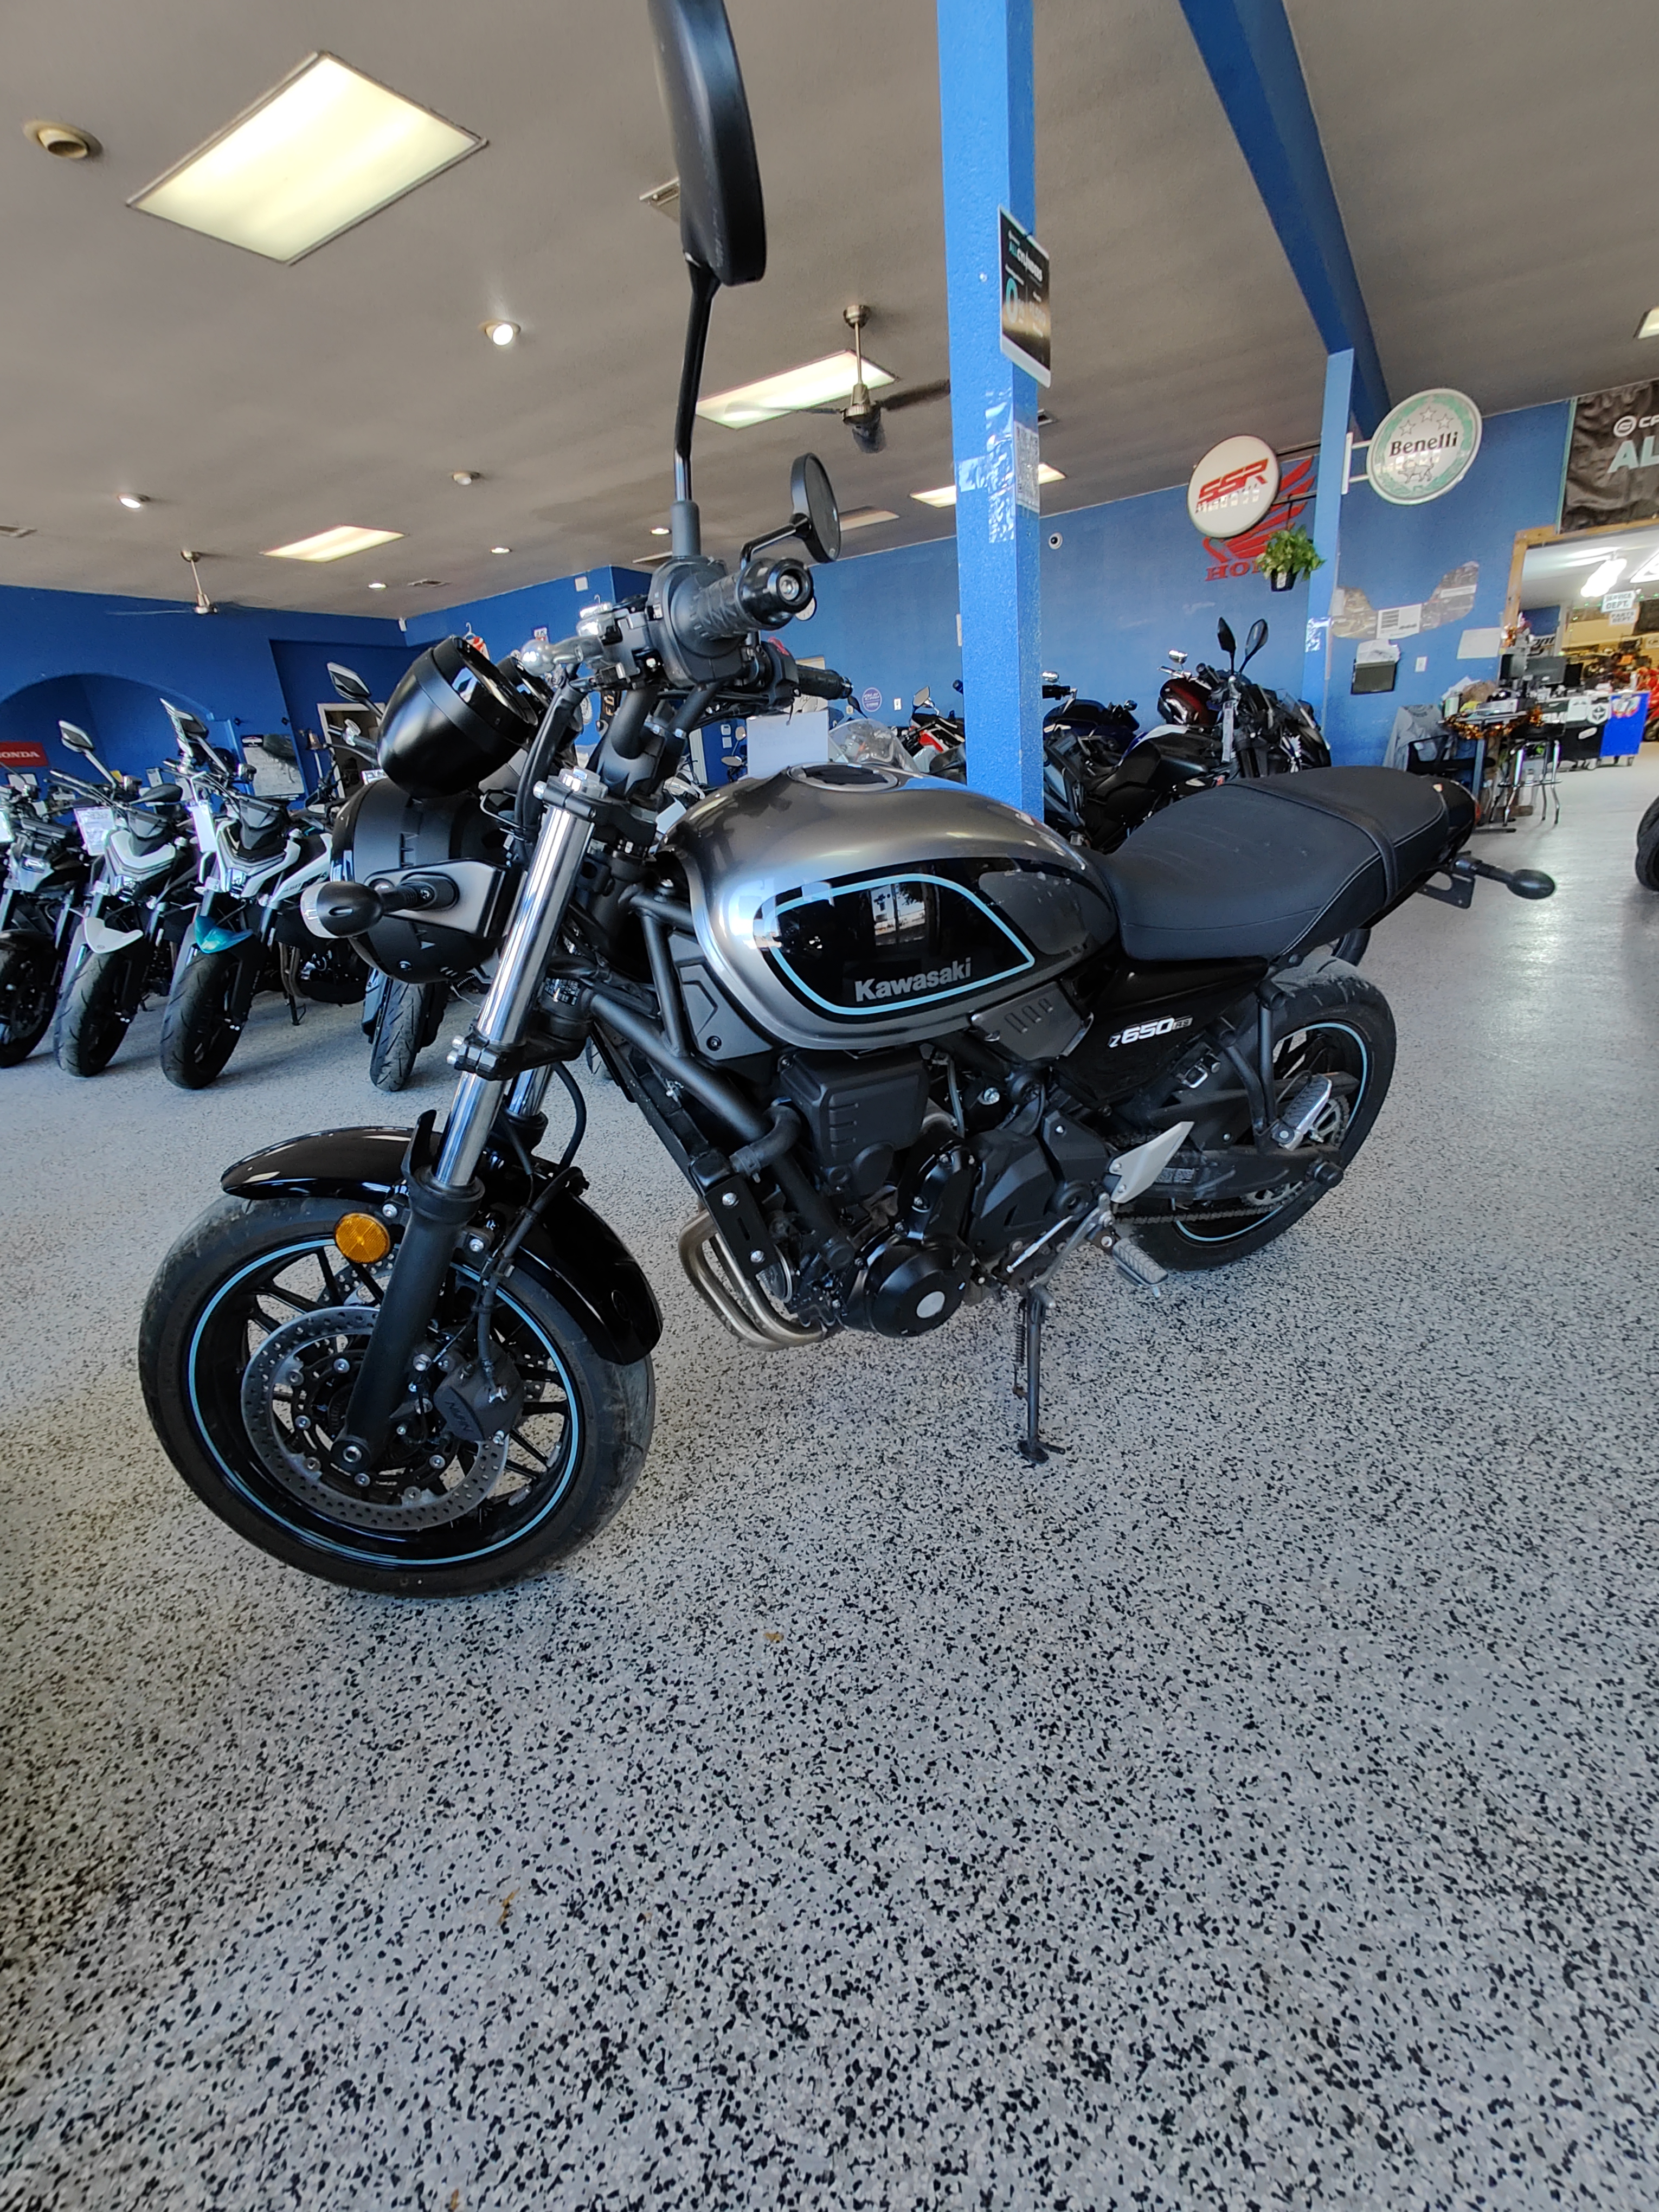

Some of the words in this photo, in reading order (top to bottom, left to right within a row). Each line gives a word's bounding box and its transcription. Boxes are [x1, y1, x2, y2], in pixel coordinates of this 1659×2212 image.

[1389, 432, 1458, 456] Benelli
[1196, 458, 1269, 504] SSR
[854, 957, 971, 1002] Kawasaki
